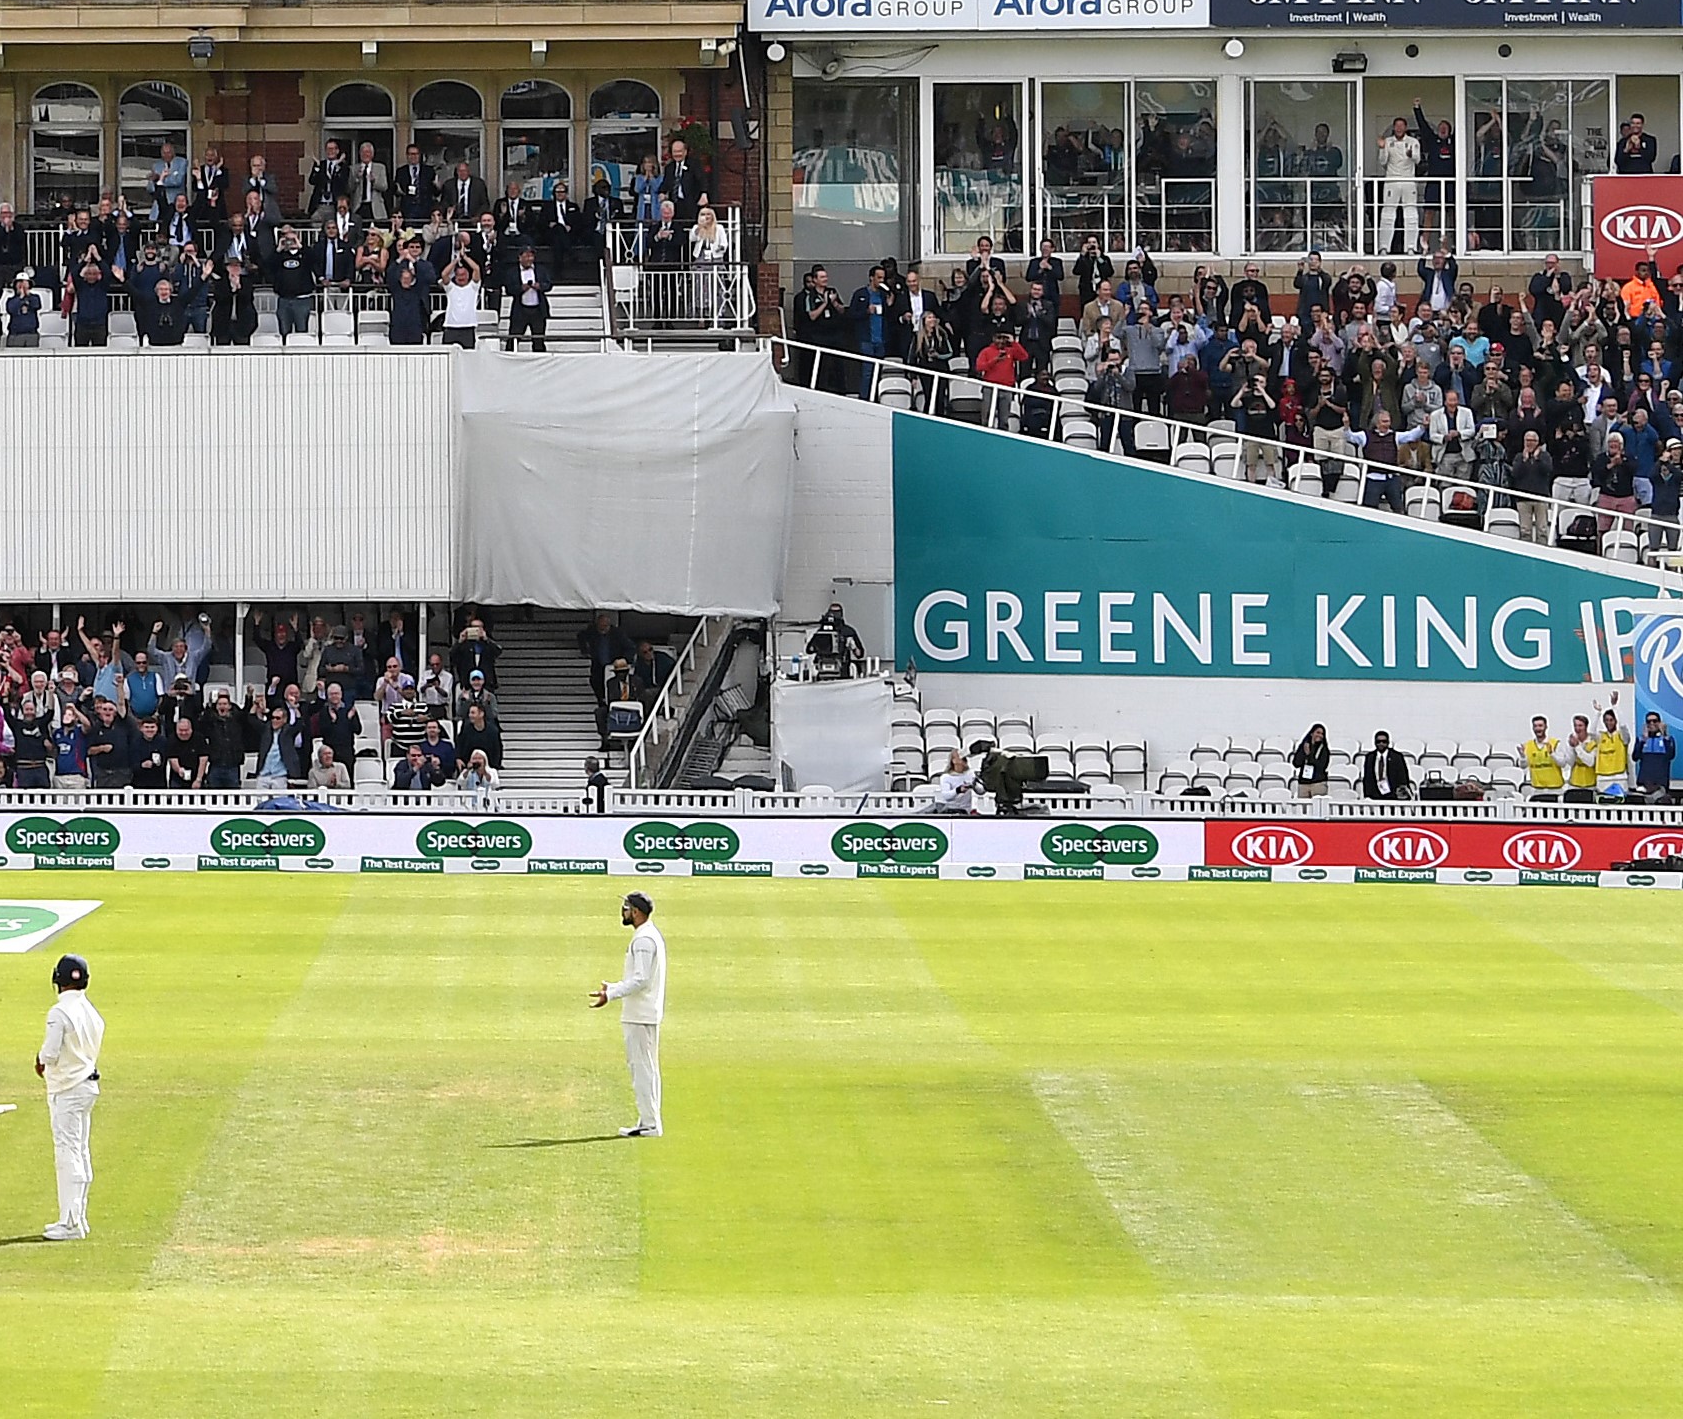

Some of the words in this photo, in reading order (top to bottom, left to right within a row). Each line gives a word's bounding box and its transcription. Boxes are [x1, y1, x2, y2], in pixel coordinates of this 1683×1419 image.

[878, 1, 962, 16] GROUP
[1108, 0, 1193, 14] GROUP
[1290, 13, 1342, 22] Investment
[1353, 13, 1386, 21] Wealth
[1505, 13, 1557, 21] Investment
[1568, 13, 1601, 21] Wealth
[1615, 214, 1673, 240] KIA
[914, 590, 1270, 665] GREENE
[1317, 595, 1550, 670] KING
[1580, 597, 1635, 683] IP
[17, 829, 109, 848] Specsavers
[222, 830, 314, 850] Specsavers
[427, 832, 521, 851] Specsavers
[635, 833, 728, 853] Specsavers
[843, 835, 937, 854] Specsavers
[1052, 836, 1147, 855] Specsavers
[1246, 836, 1299, 859] KIA
[1383, 838, 1434, 860] KIA
[1517, 840, 1568, 863] KIA
[39, 856, 55, 864] The
[57, 856, 75, 865] Test
[77, 857, 112, 866] Experts
[202, 858, 218, 866] The
[221, 858, 238, 866] Test
[240, 858, 276, 867] Experts
[530, 861, 547, 870] The
[548, 861, 567, 869] Test
[569, 862, 605, 870] Experts
[694, 862, 712, 870] The
[714, 862, 732, 870] Test
[734, 863, 770, 872] Experts
[1026, 867, 1044, 876] The
[1045, 868, 1064, 876] Test
[1067, 868, 1101, 877] Experts
[1192, 869, 1210, 877] The
[1211, 869, 1230, 877] Test
[1232, 869, 1268, 878] Experts
[1523, 871, 1539, 880] The
[1541, 873, 1558, 881] Test
[1560, 873, 1596, 882] Experts
